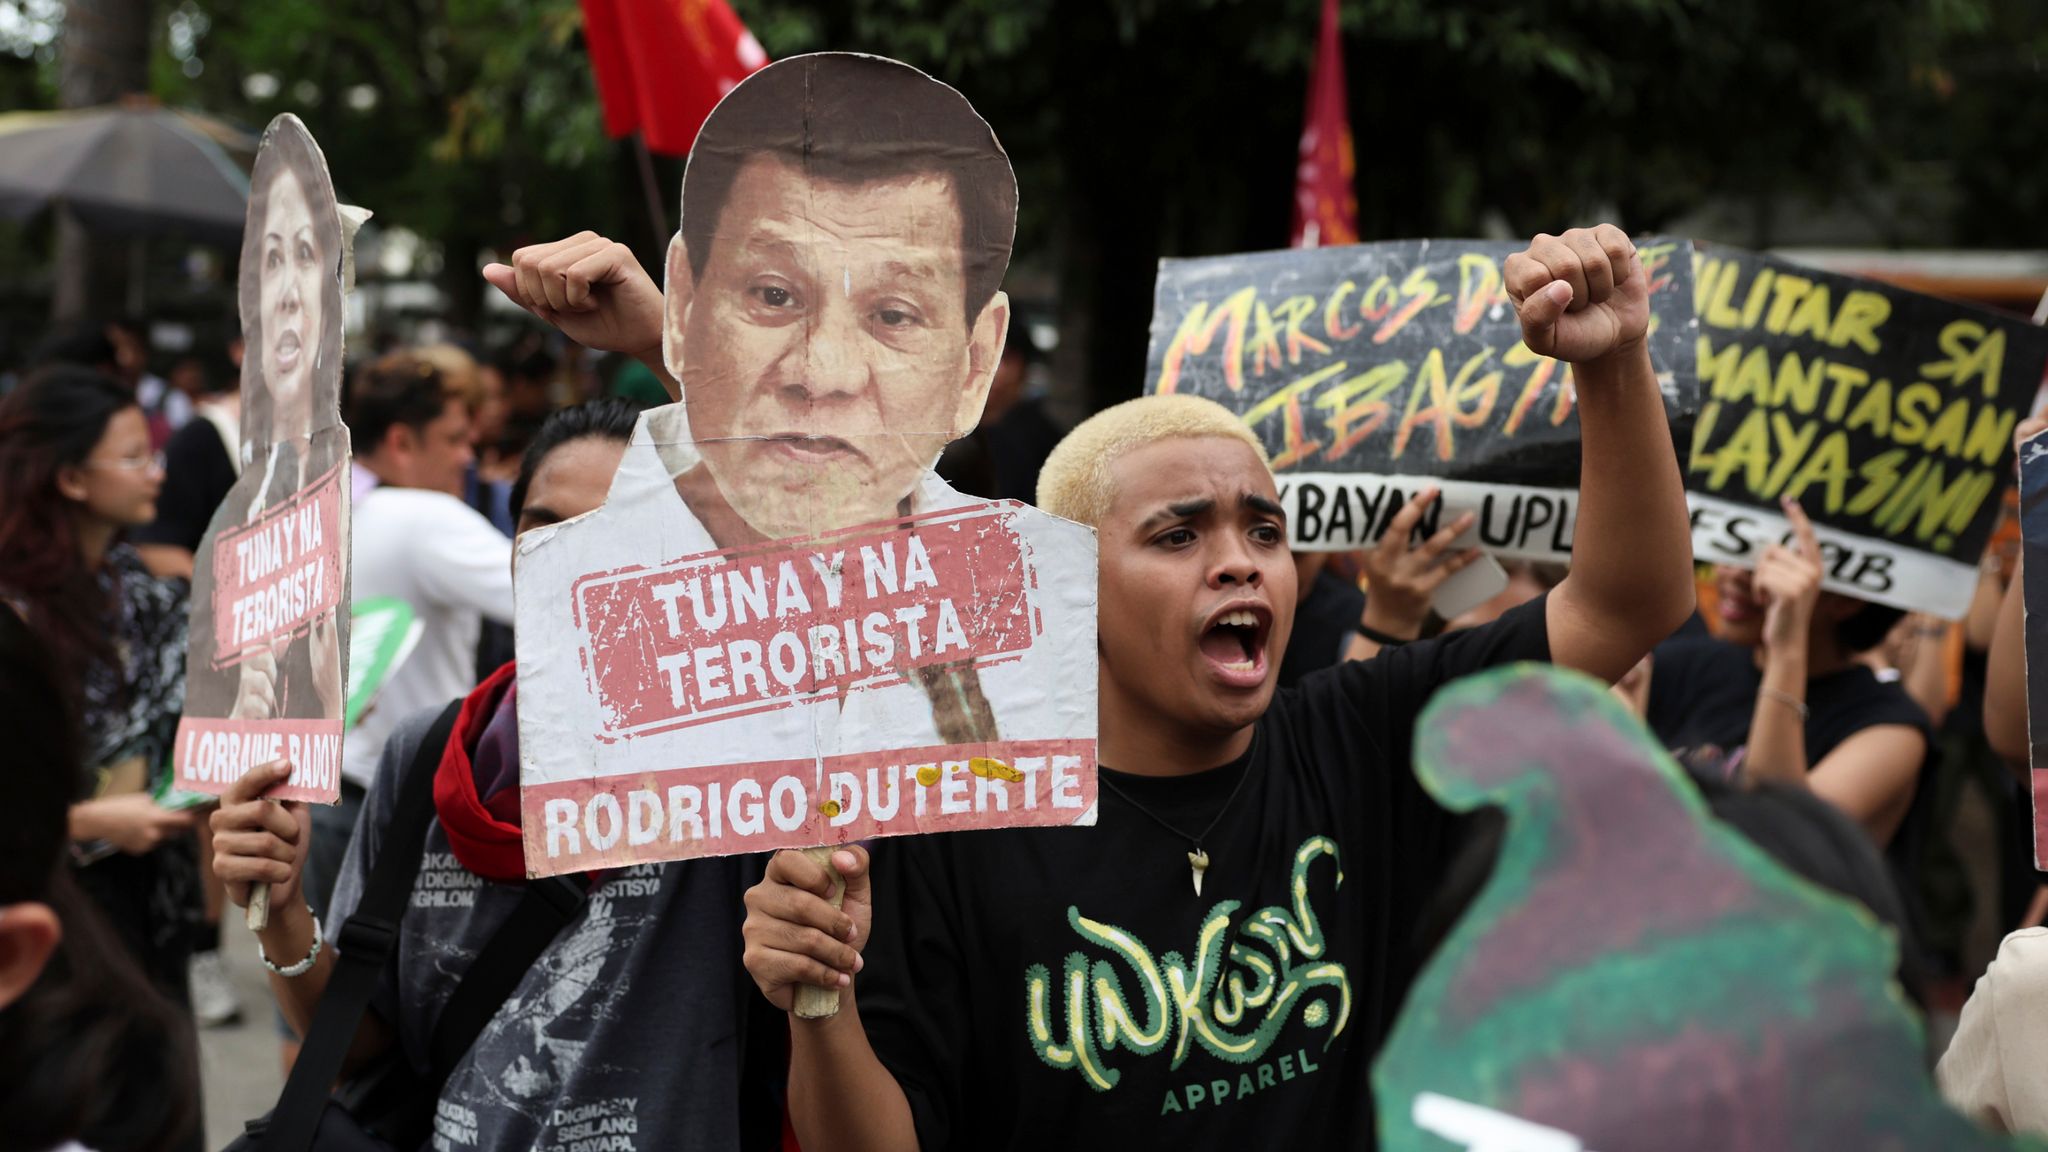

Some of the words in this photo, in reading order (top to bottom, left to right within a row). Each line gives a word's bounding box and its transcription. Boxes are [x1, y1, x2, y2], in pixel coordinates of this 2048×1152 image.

[1692, 251, 1892, 355] ILITAR
[1920, 318, 2007, 398] SA
[236, 512, 297, 589] TUNAY
[300, 498, 323, 556] NA
[1480, 493, 1574, 552] UPL
[232, 555, 324, 647] TERORISTA
[652, 549, 846, 638] TUNAY
[859, 534, 938, 600] NA
[656, 599, 970, 710] TERORISTA
[287, 733, 340, 791] BADOY
[544, 775, 809, 858] RODRIGO
[828, 755, 1084, 828] DUTERTE
[1161, 1049, 1319, 1115] APPAREL
[557, 1116, 638, 1143] SISILANG
